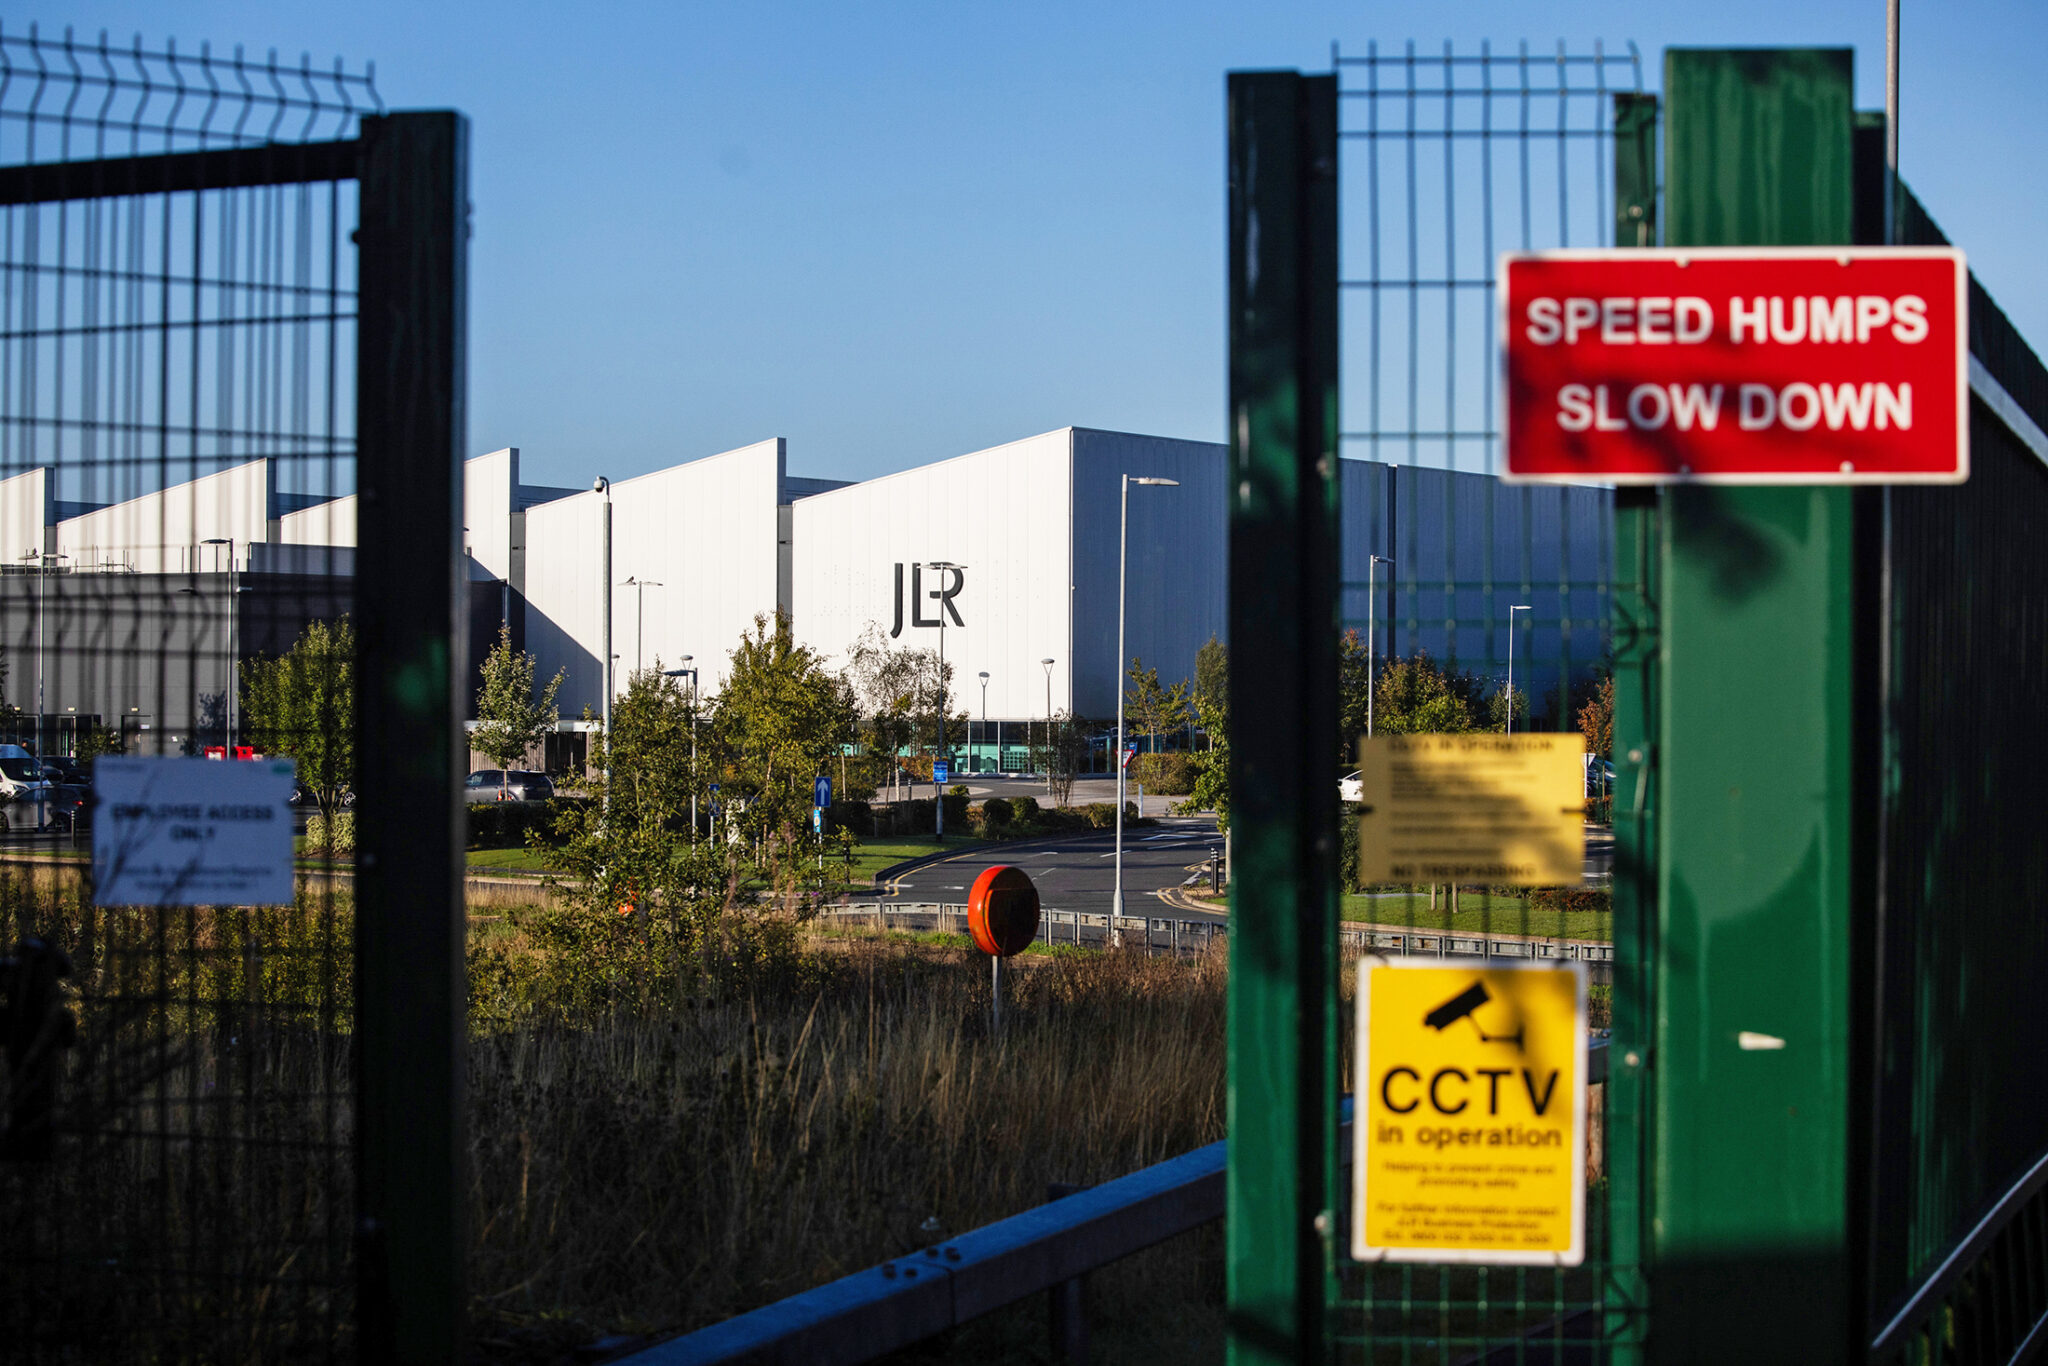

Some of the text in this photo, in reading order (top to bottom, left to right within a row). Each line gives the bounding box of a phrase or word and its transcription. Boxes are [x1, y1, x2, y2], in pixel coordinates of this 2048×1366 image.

[1526, 295, 1929, 345] SPEED HUMPS
[1556, 381, 1913, 432] SLOW DOWN
[890, 562, 966, 639] JLR
[1382, 1066, 1560, 1116] CCTV
[1378, 1121, 1562, 1151] in operation
